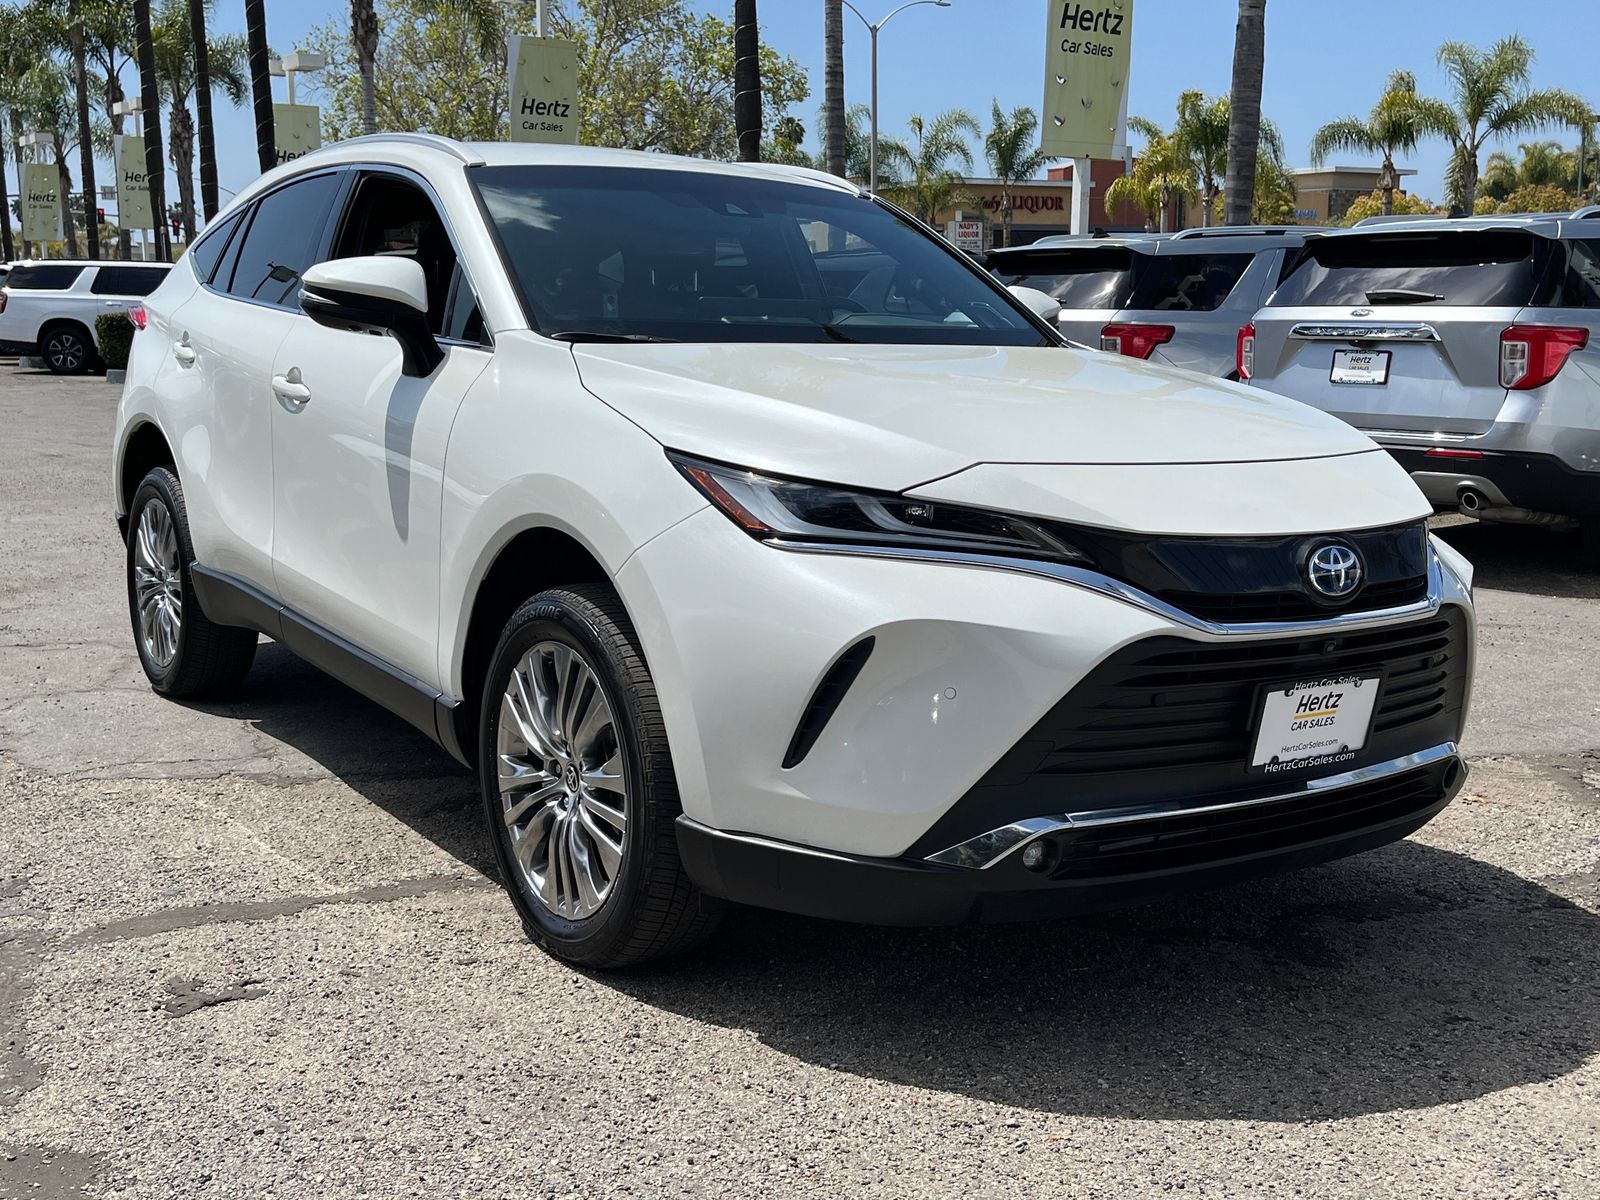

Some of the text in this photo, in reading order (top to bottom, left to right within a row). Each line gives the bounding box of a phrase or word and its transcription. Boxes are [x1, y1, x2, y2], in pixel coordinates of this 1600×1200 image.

[1060, 3, 1124, 35] Hertz
[1061, 39, 1113, 57] Car Sales
[521, 98, 570, 117] Hertz
[522, 121, 563, 132] Car Sales
[125, 171, 149, 182] Her
[28, 192, 56, 202] Hertz
[1012, 195, 1064, 213] LIQUOR
[958, 231, 979, 239] LIQUOR
[1350, 355, 1372, 364] Hertz
[1294, 676, 1361, 690] Hertz Car Sales
[1296, 691, 1343, 713] Hertz
[1291, 716, 1335, 731] CAR SALES
[1281, 738, 1338, 753] HertzCarSales.com
[1264, 752, 1355, 773] HertzCarSales.com
